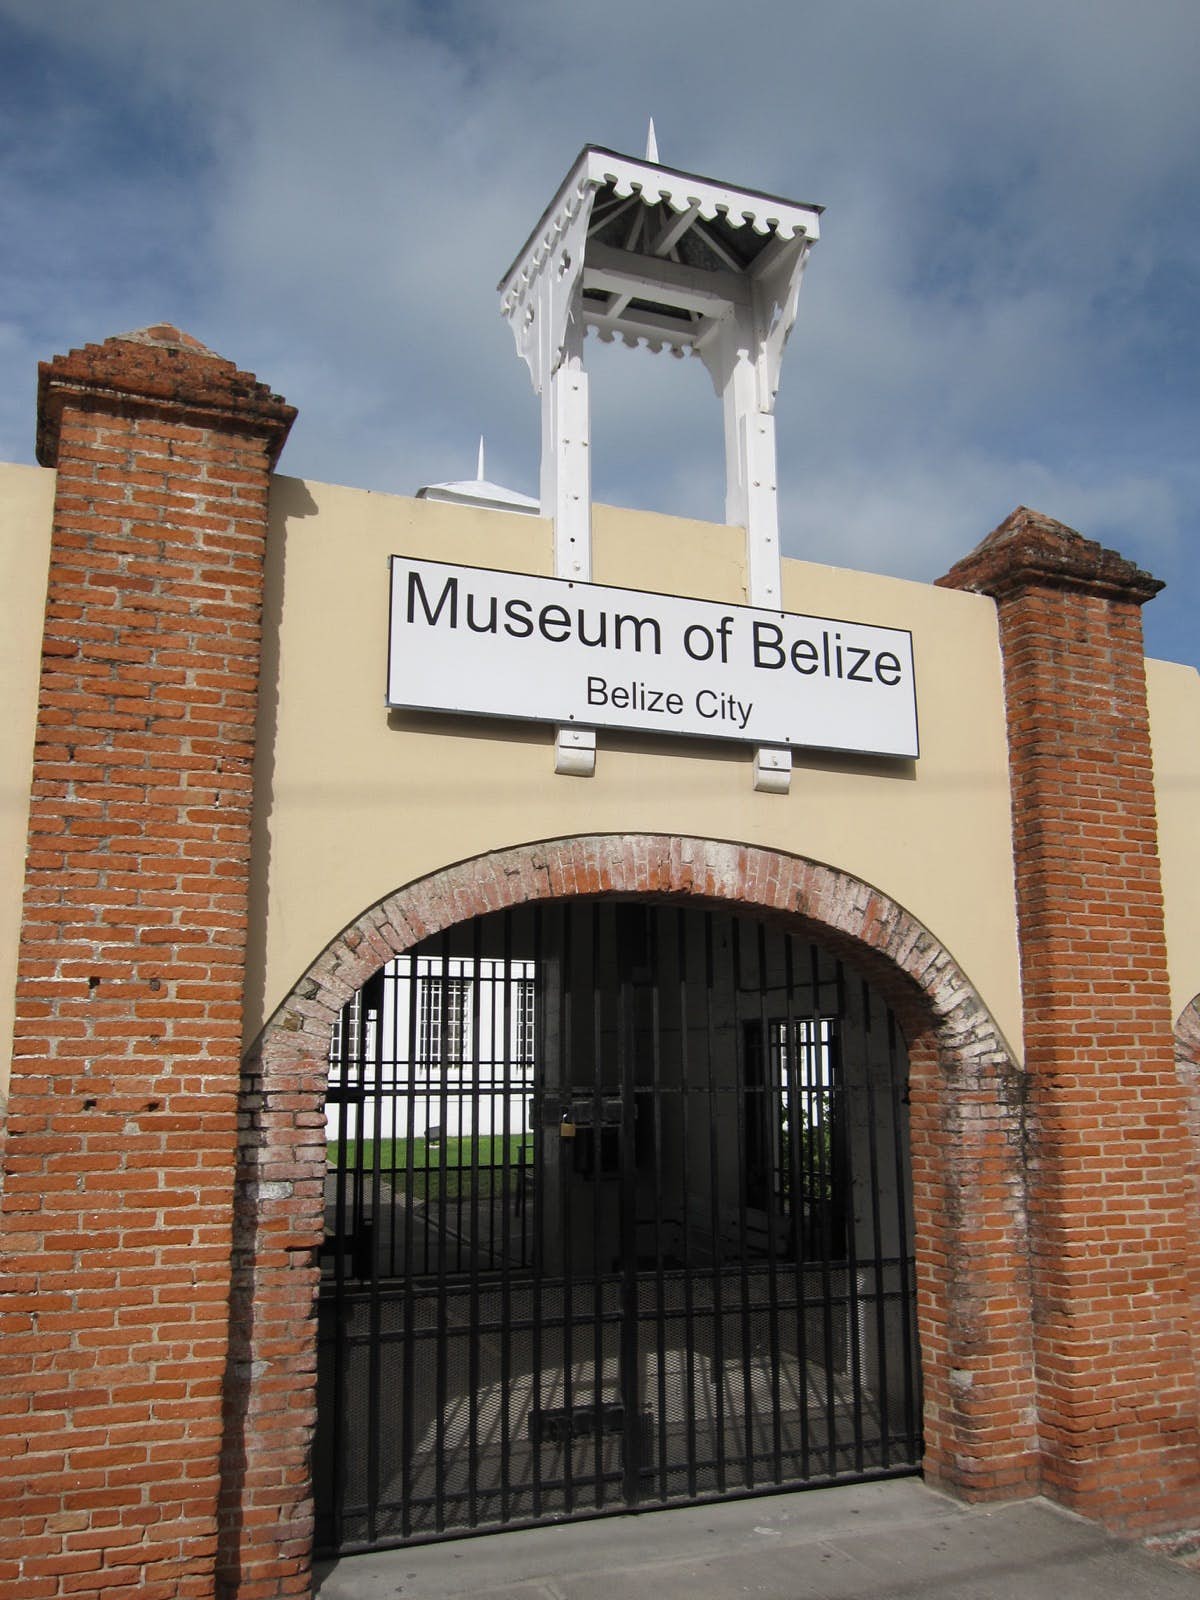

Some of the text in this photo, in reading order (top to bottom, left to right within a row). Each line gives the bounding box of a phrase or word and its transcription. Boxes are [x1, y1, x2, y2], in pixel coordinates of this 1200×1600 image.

[406, 571, 902, 686] Museum of Belize
[587, 676, 753, 730] Belize City
